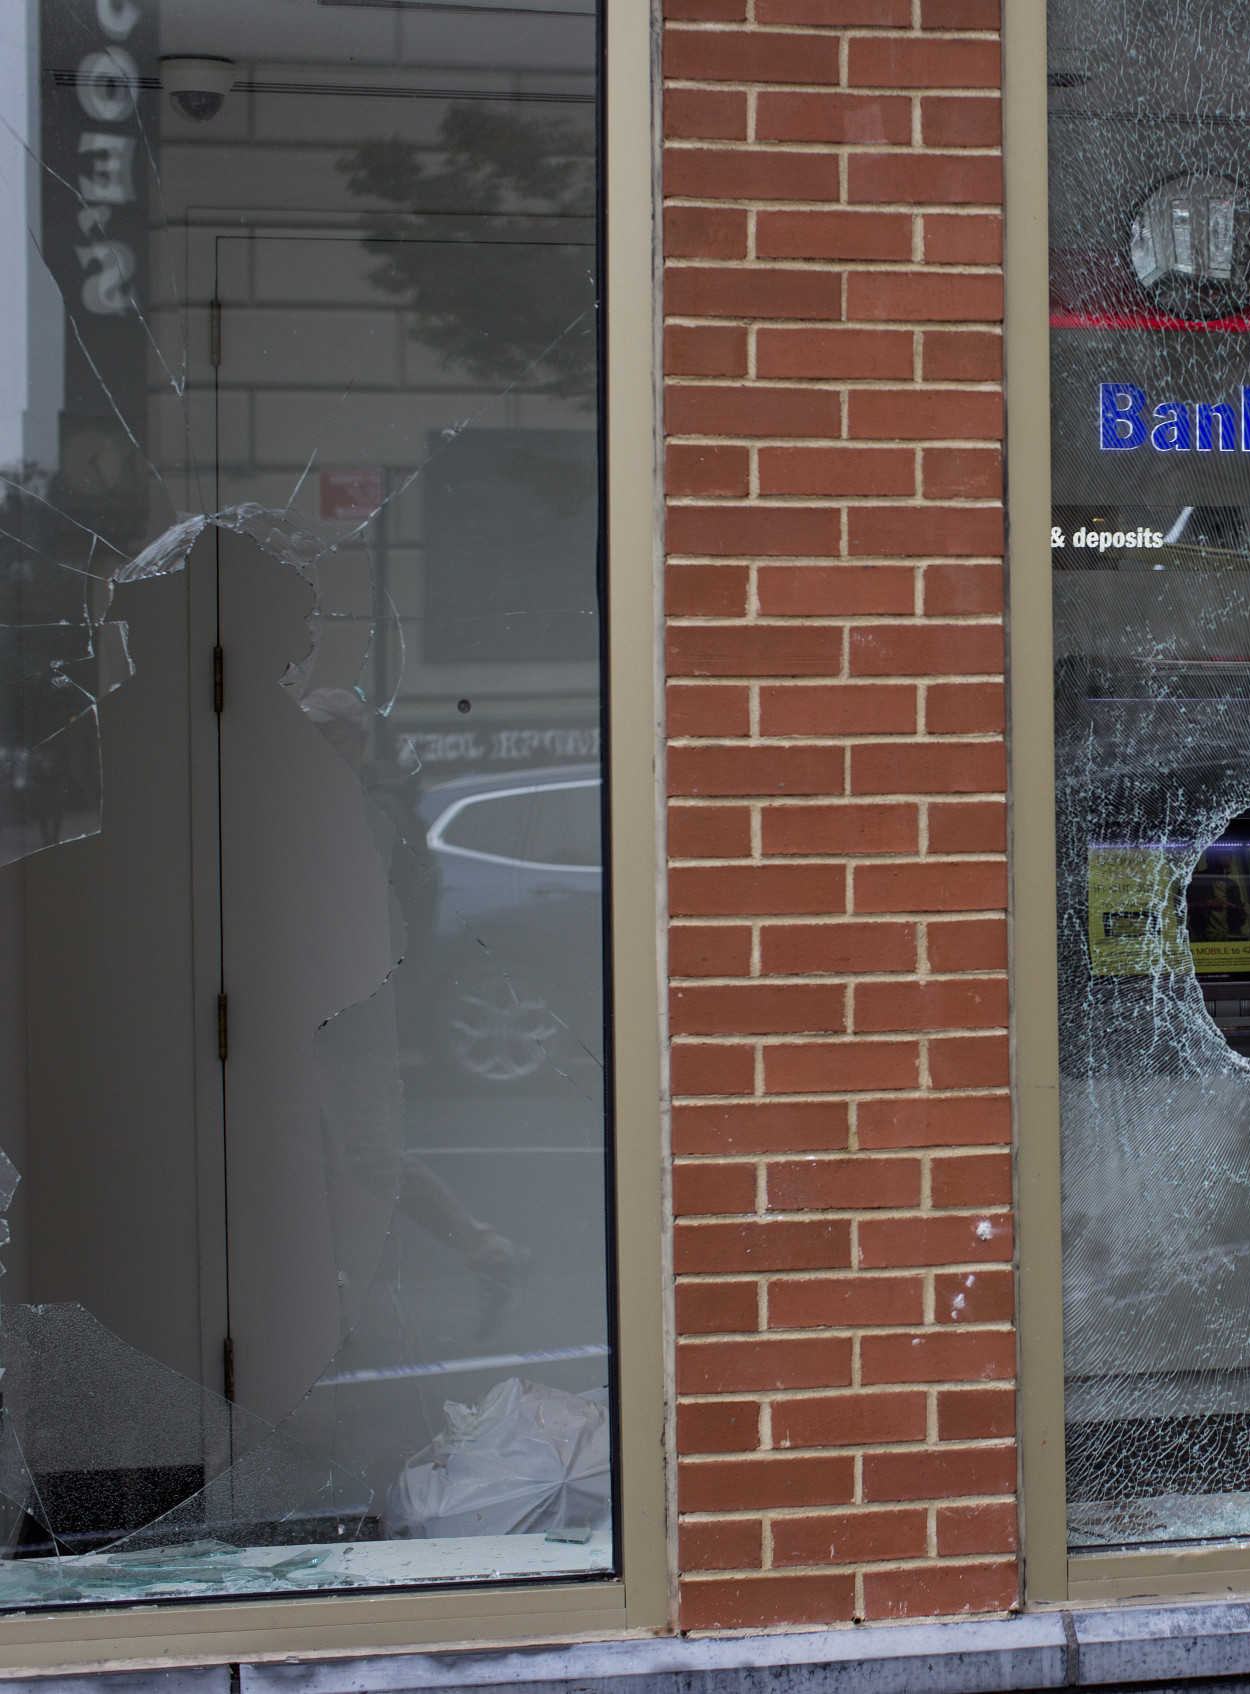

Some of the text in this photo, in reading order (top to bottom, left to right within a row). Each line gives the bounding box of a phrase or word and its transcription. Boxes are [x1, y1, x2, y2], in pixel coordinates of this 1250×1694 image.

[1050, 525, 1164, 553] & deposits
[1196, 947, 1229, 955] MOBILE
